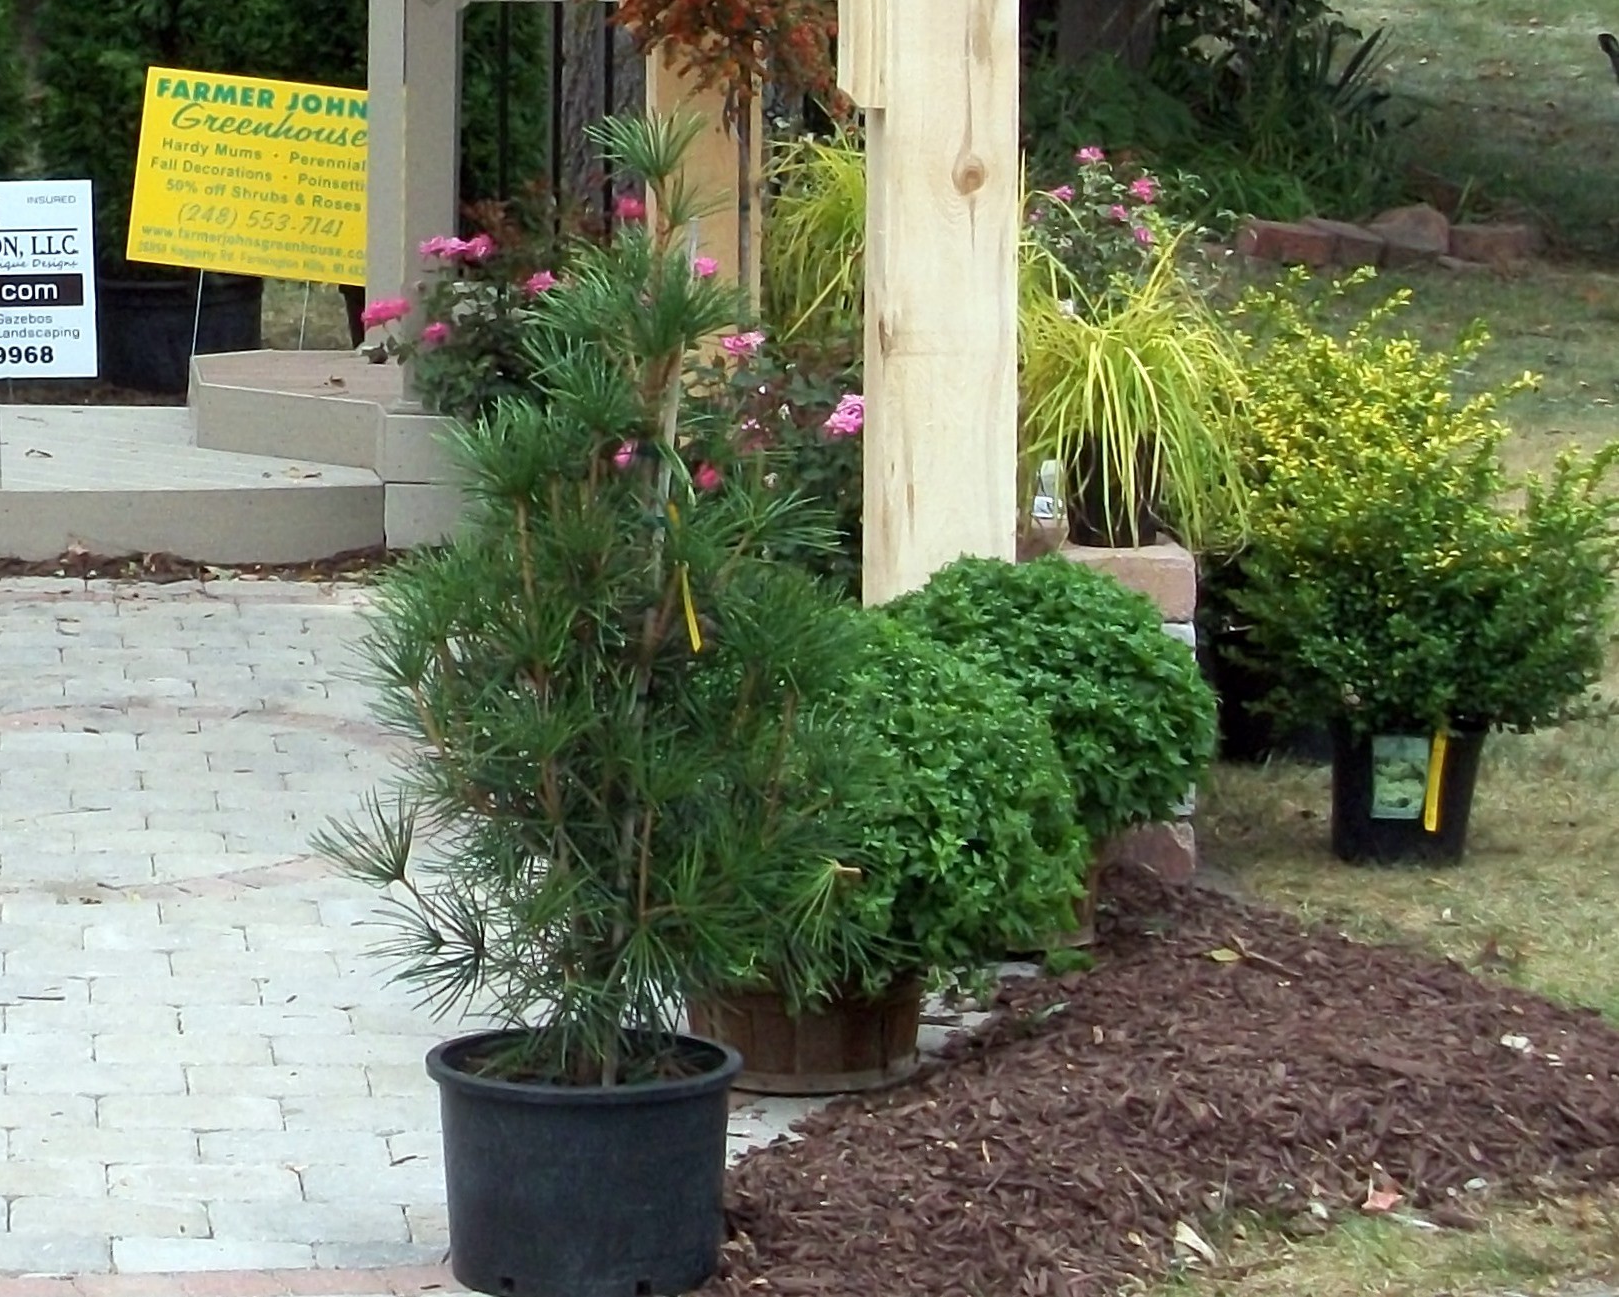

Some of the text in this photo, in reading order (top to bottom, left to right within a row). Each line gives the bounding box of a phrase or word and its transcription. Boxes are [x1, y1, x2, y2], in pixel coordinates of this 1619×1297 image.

[156, 78, 275, 109] FARMER
[171, 102, 367, 147] Greenhouse
[162, 137, 209, 157] Hardy
[215, 143, 262, 160] Mums
[150, 156, 178, 171] Fall
[182, 160, 273, 182] Decorations
[26, 195, 77, 205] INSURED
[166, 178, 362, 212] 50% off Shrubs & Roses
[178, 203, 344, 237] (248) 553-7141
